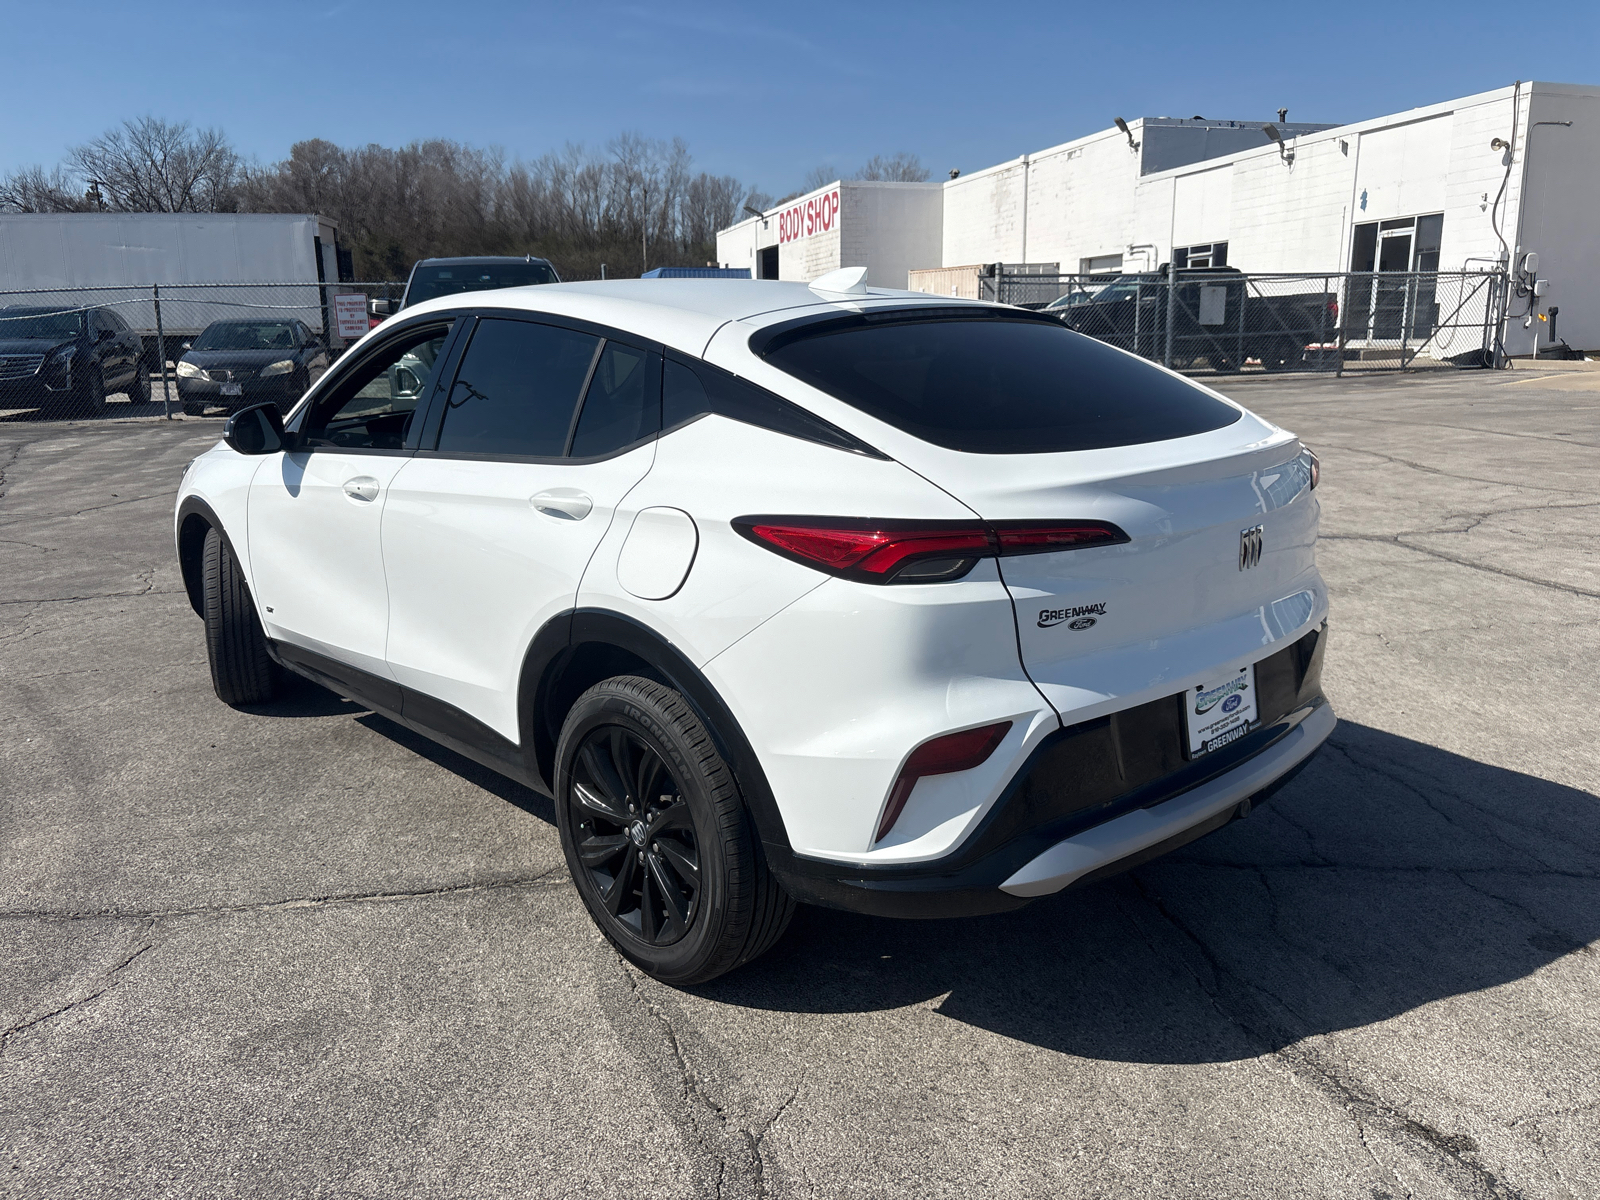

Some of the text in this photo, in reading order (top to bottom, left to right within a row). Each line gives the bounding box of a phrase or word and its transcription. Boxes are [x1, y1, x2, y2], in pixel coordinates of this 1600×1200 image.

[1039, 602, 1106, 622] GREENWAY
[1073, 618, 1092, 629] Ford
[1195, 674, 1247, 709] GREENWAY
[623, 705, 692, 781] IRONMAN
[1207, 723, 1248, 752] GREENWAY
